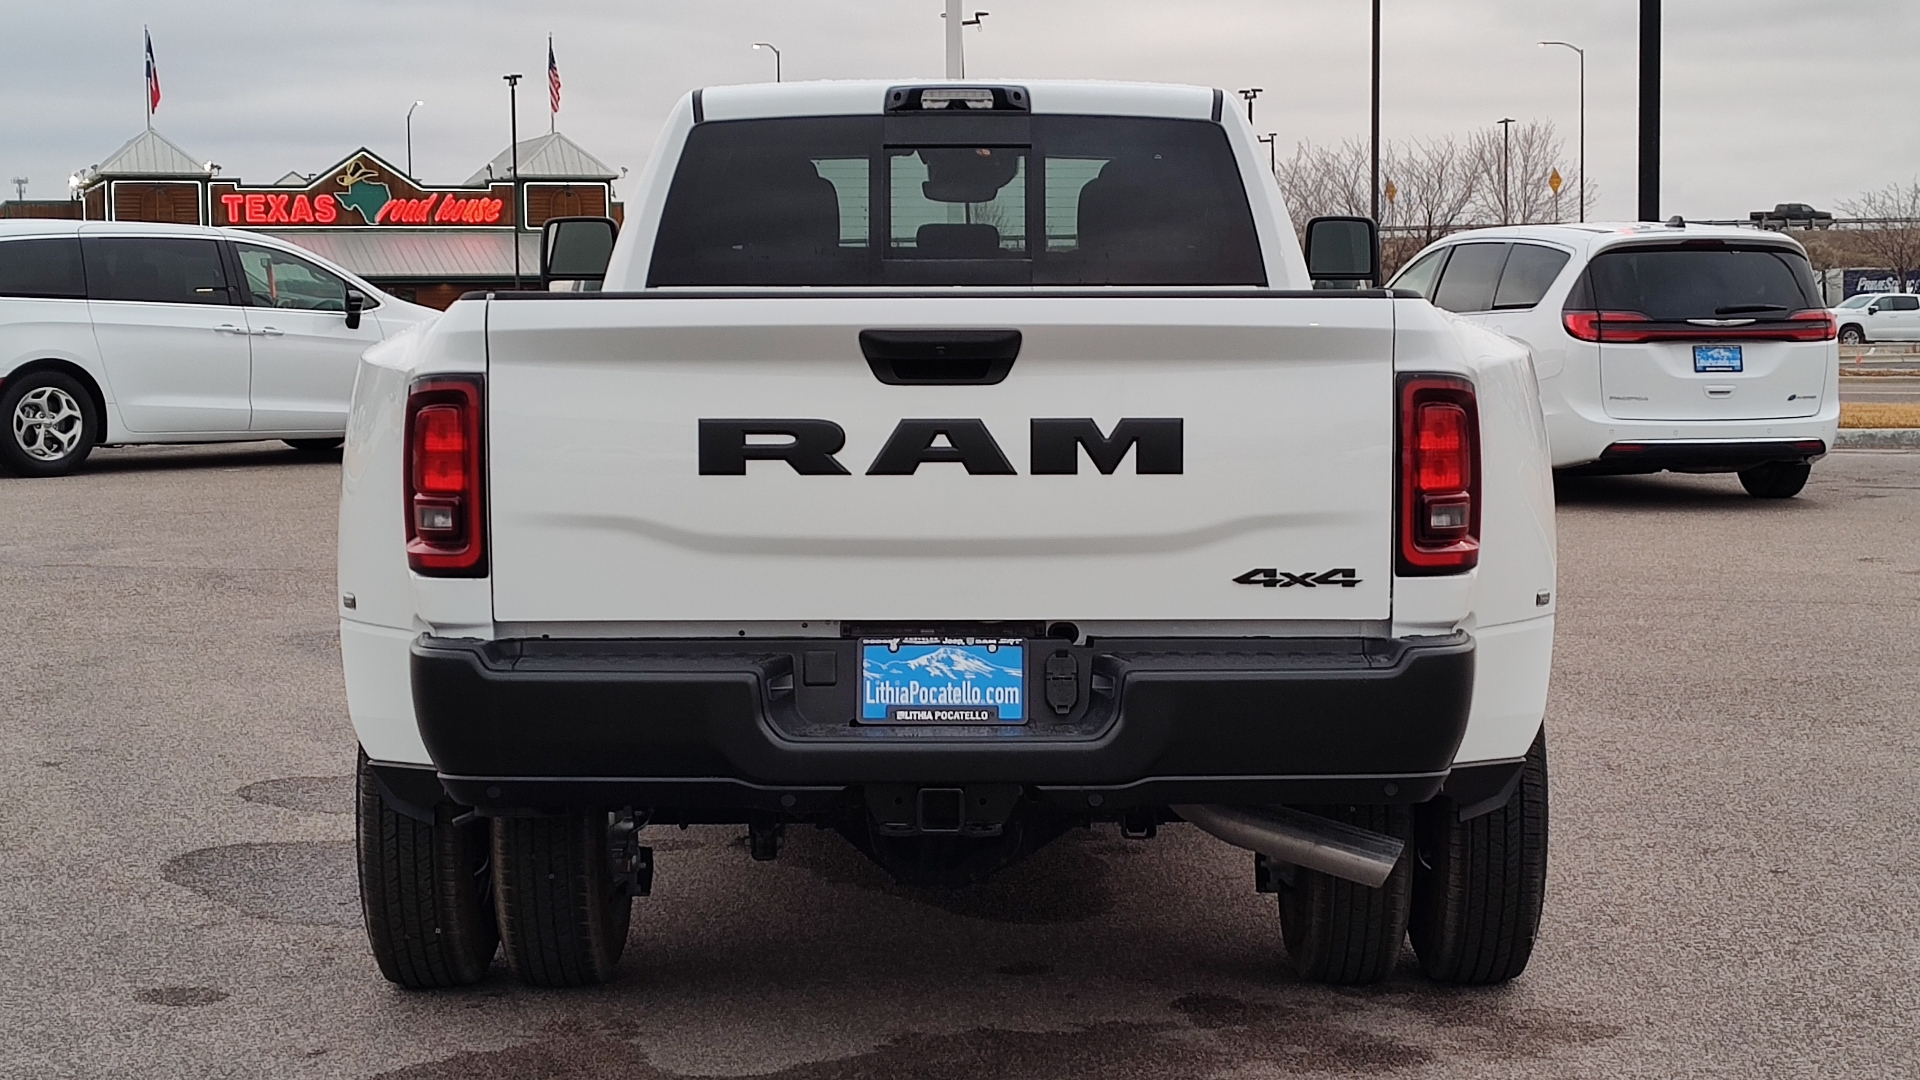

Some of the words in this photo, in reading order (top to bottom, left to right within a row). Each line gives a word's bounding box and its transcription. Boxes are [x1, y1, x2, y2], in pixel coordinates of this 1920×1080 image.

[221, 194, 337, 223] TEXAS
[698, 418, 1185, 476] RAM
[1232, 568, 1363, 587] 4x4
[866, 680, 1020, 704] LithiaPocatello.com
[905, 710, 934, 721] LITHIA
[934, 710, 989, 721] POCATELLO
